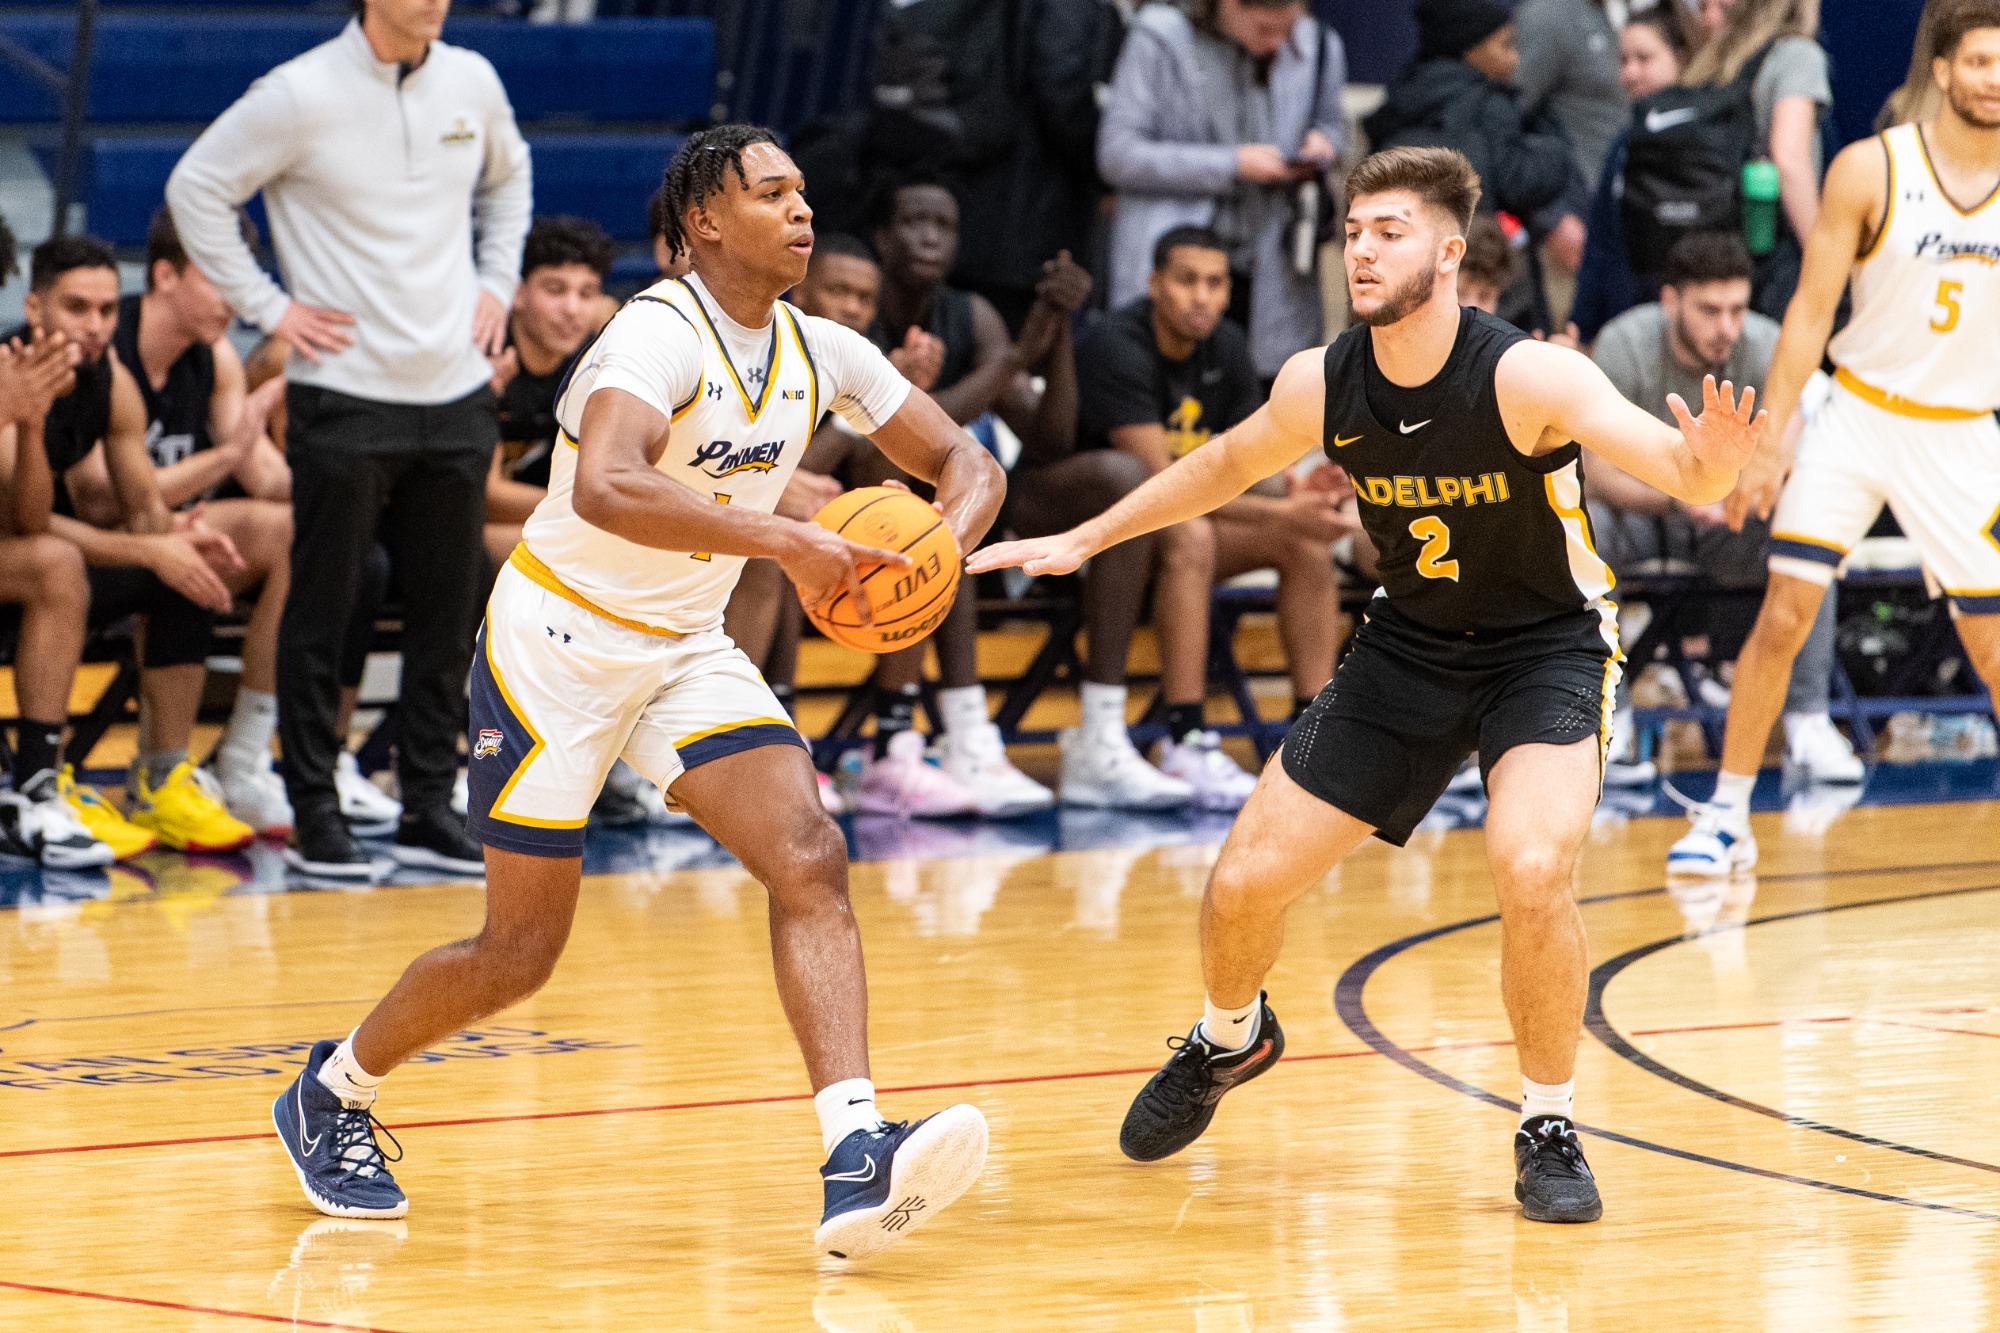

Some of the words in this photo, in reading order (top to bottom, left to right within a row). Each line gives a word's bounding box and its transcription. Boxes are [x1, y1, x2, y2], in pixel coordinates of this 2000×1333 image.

[1929, 279, 1963, 333] 5
[1409, 515, 1460, 582] 2
[894, 552, 942, 603] EVO
